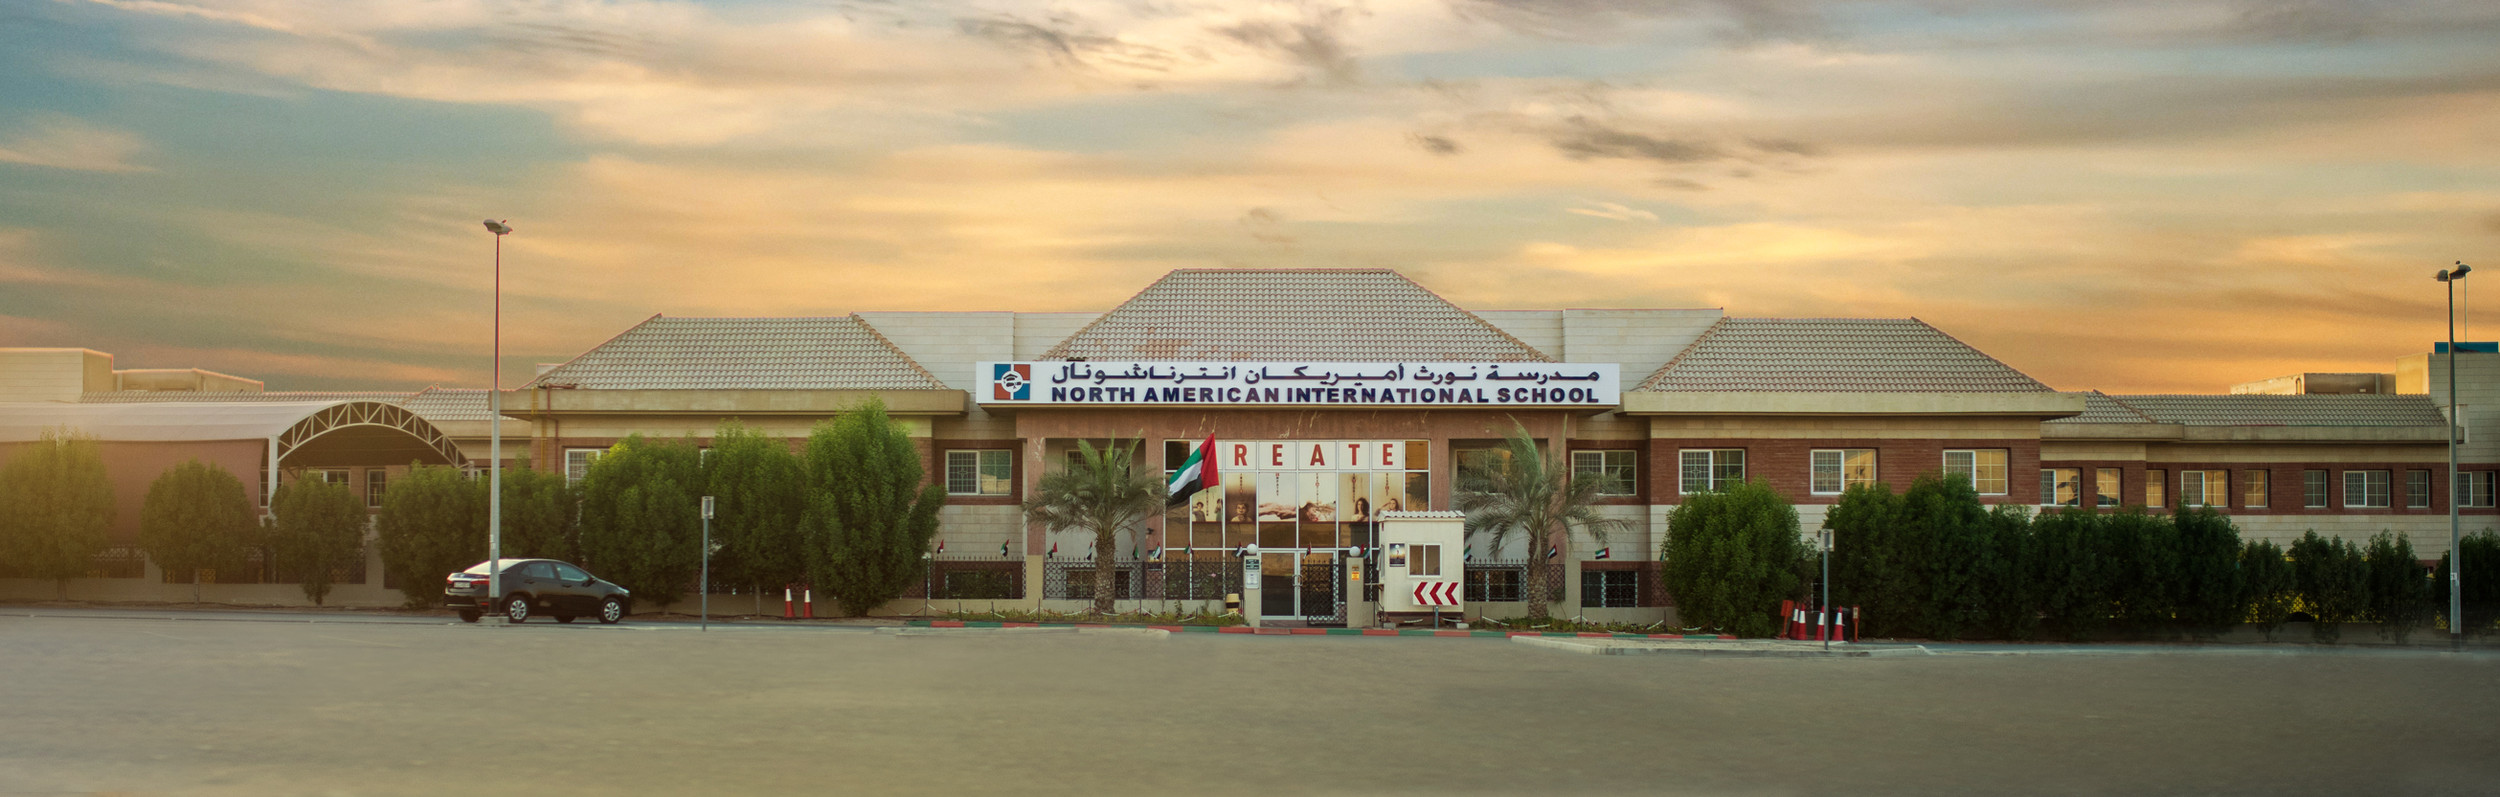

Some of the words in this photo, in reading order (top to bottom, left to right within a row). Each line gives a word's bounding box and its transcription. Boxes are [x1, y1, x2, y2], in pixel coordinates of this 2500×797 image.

[1052, 363, 1236, 385] انترناشونال
[1245, 363, 1404, 386] أميريكان
[1414, 366, 1477, 385] نورث
[1486, 365, 1600, 385] مدرسة
[1052, 387, 1134, 402] NORTH
[1143, 387, 1279, 402] AMERICAN
[1287, 388, 1489, 403] INTERNATIONAL
[1497, 388, 1599, 403] SCHOOL
[1234, 443, 1393, 466] REATE
